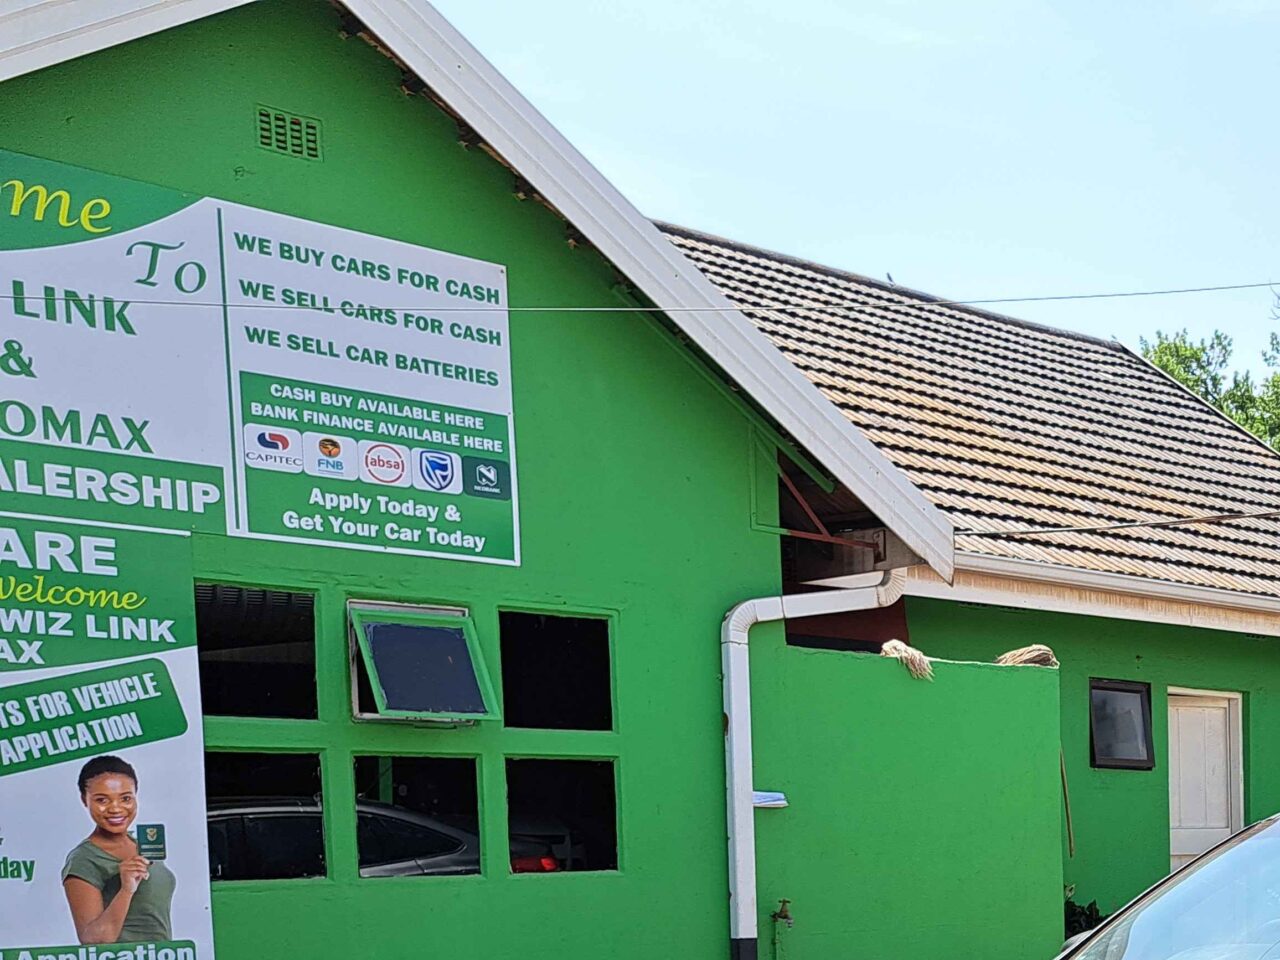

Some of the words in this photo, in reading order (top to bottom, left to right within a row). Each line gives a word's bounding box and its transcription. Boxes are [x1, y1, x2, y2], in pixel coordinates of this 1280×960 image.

[126, 240, 207, 294] To
[234, 232, 272, 256] WE
[279, 242, 325, 267] BUY
[331, 254, 391, 282] CARS
[397, 268, 440, 292] FOR
[445, 280, 500, 305] CASH
[12, 280, 137, 335] LINK
[238, 279, 275, 302] WE
[281, 288, 335, 313] SELL
[340, 300, 397, 325] CARS
[403, 313, 443, 335] FOR
[449, 323, 502, 346] CASH
[0, 339, 38, 379] &
[245, 326, 281, 348] WE
[287, 334, 340, 358] SELL
[346, 345, 389, 367] CAR
[395, 354, 499, 387] BATTERIES
[251, 402, 299, 421] BANK
[303, 410, 374, 433] FINANCE
[377, 422, 460, 446] AVAILABLE
[463, 436, 503, 453] HERE
[270, 383, 316, 403] CASH
[320, 391, 353, 409] BUY
[357, 398, 441, 423] AVAILABLE
[444, 413, 485, 430] HERE
[246, 451, 302, 467] CAPITEC
[317, 458, 344, 471] FNB
[369, 456, 400, 470] absa
[309, 488, 372, 515] Apply
[377, 496, 439, 522] Today
[444, 504, 462, 522] &
[282, 511, 324, 532] Get
[328, 516, 379, 537] Your
[384, 522, 421, 542] Car
[426, 527, 486, 553] Today
[0, 608, 74, 636] WIZ
[86, 614, 177, 643] LINK
[26, 691, 74, 722] FOR
[72, 673, 161, 712] VEHICLE
[0, 712, 143, 765] APPLICATION
